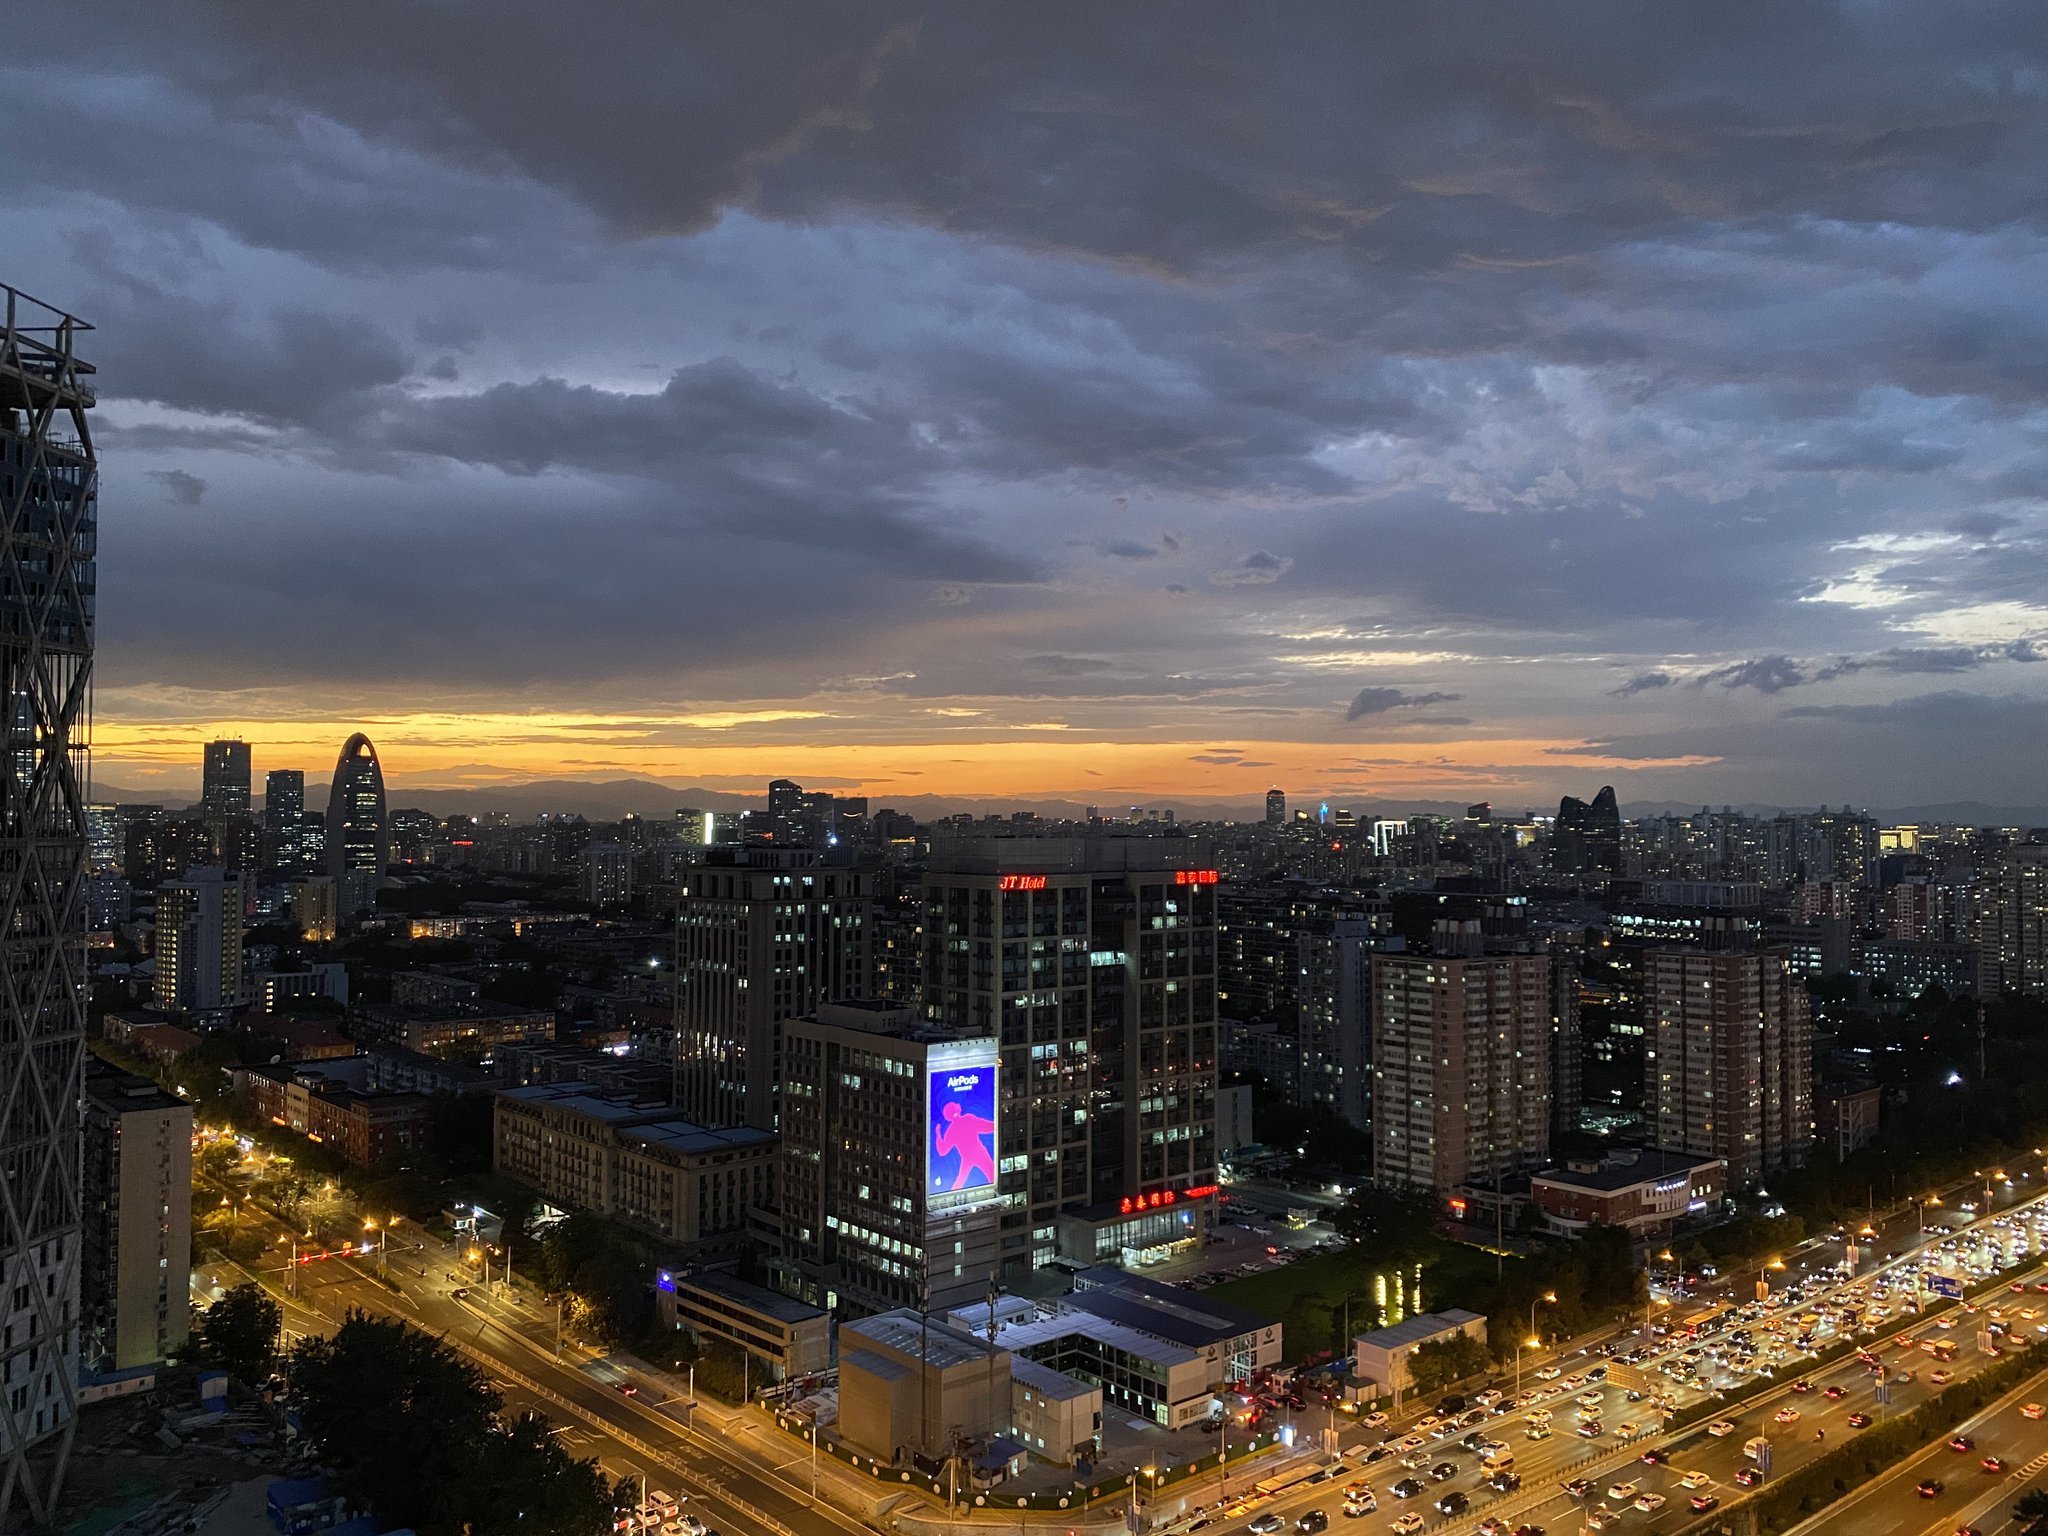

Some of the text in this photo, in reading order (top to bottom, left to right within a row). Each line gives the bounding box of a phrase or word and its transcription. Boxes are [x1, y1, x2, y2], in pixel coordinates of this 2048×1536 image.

[1000, 876, 1046, 889] JT Hotel
[947, 1074, 979, 1088] AirPods
